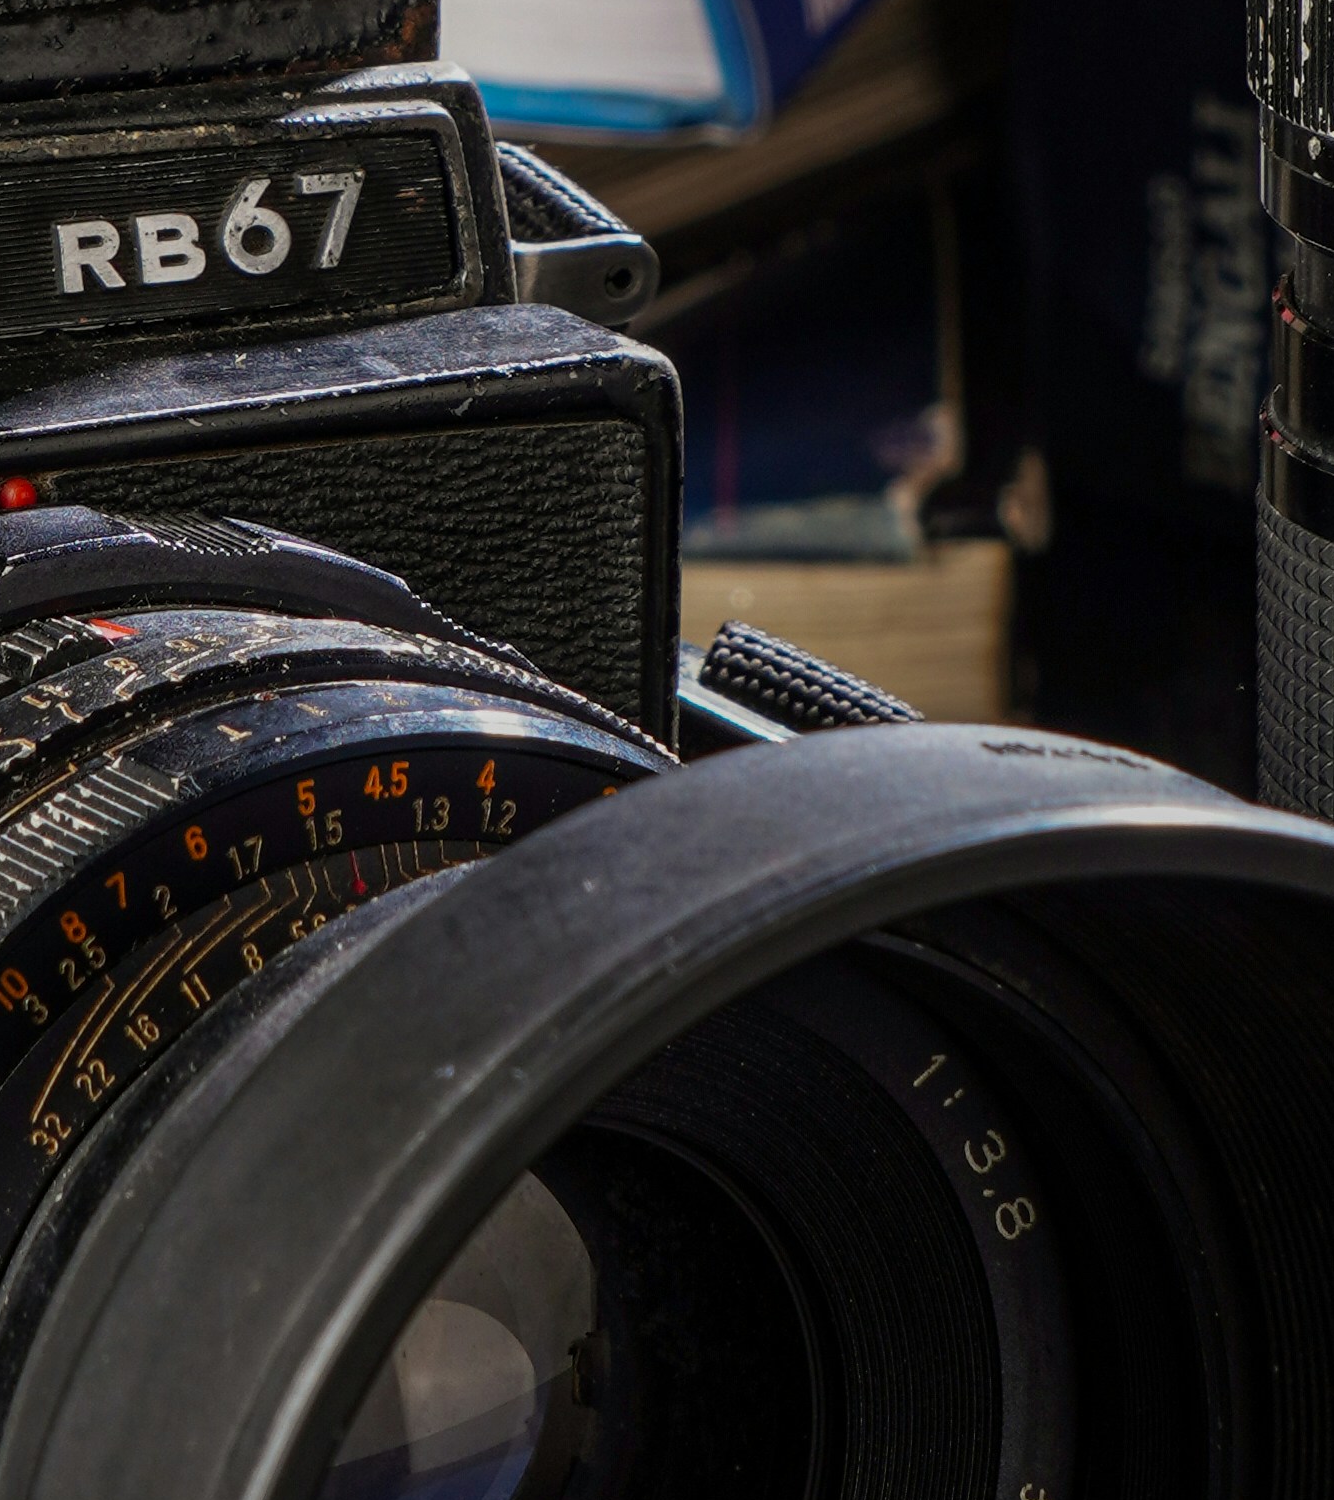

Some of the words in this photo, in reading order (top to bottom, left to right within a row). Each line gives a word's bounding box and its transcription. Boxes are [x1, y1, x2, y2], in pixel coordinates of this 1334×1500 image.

[53, 167, 365, 296] RB67
[364, 760, 410, 800] 4.5
[475, 759, 496, 795] 4
[296, 777, 316, 817] 5
[413, 795, 451, 832] 1.3
[305, 809, 343, 851] 1.5
[481, 798, 517, 837] 1.2
[182, 825, 209, 861] 6
[225, 835, 265, 881] 1.7
[104, 870, 128, 910] 7
[152, 884, 178, 920] 2
[60, 908, 88, 944] 8
[59, 934, 107, 992] 2.5
[240, 941, 265, 973] 8
[22, 994, 49, 1026] 3
[180, 973, 212, 1009] 11
[124, 1013, 162, 1051] 16
[73, 1057, 116, 1101] 22
[30, 1111, 72, 1157] 32
[910, 1050, 1038, 1241] 1:3.8
